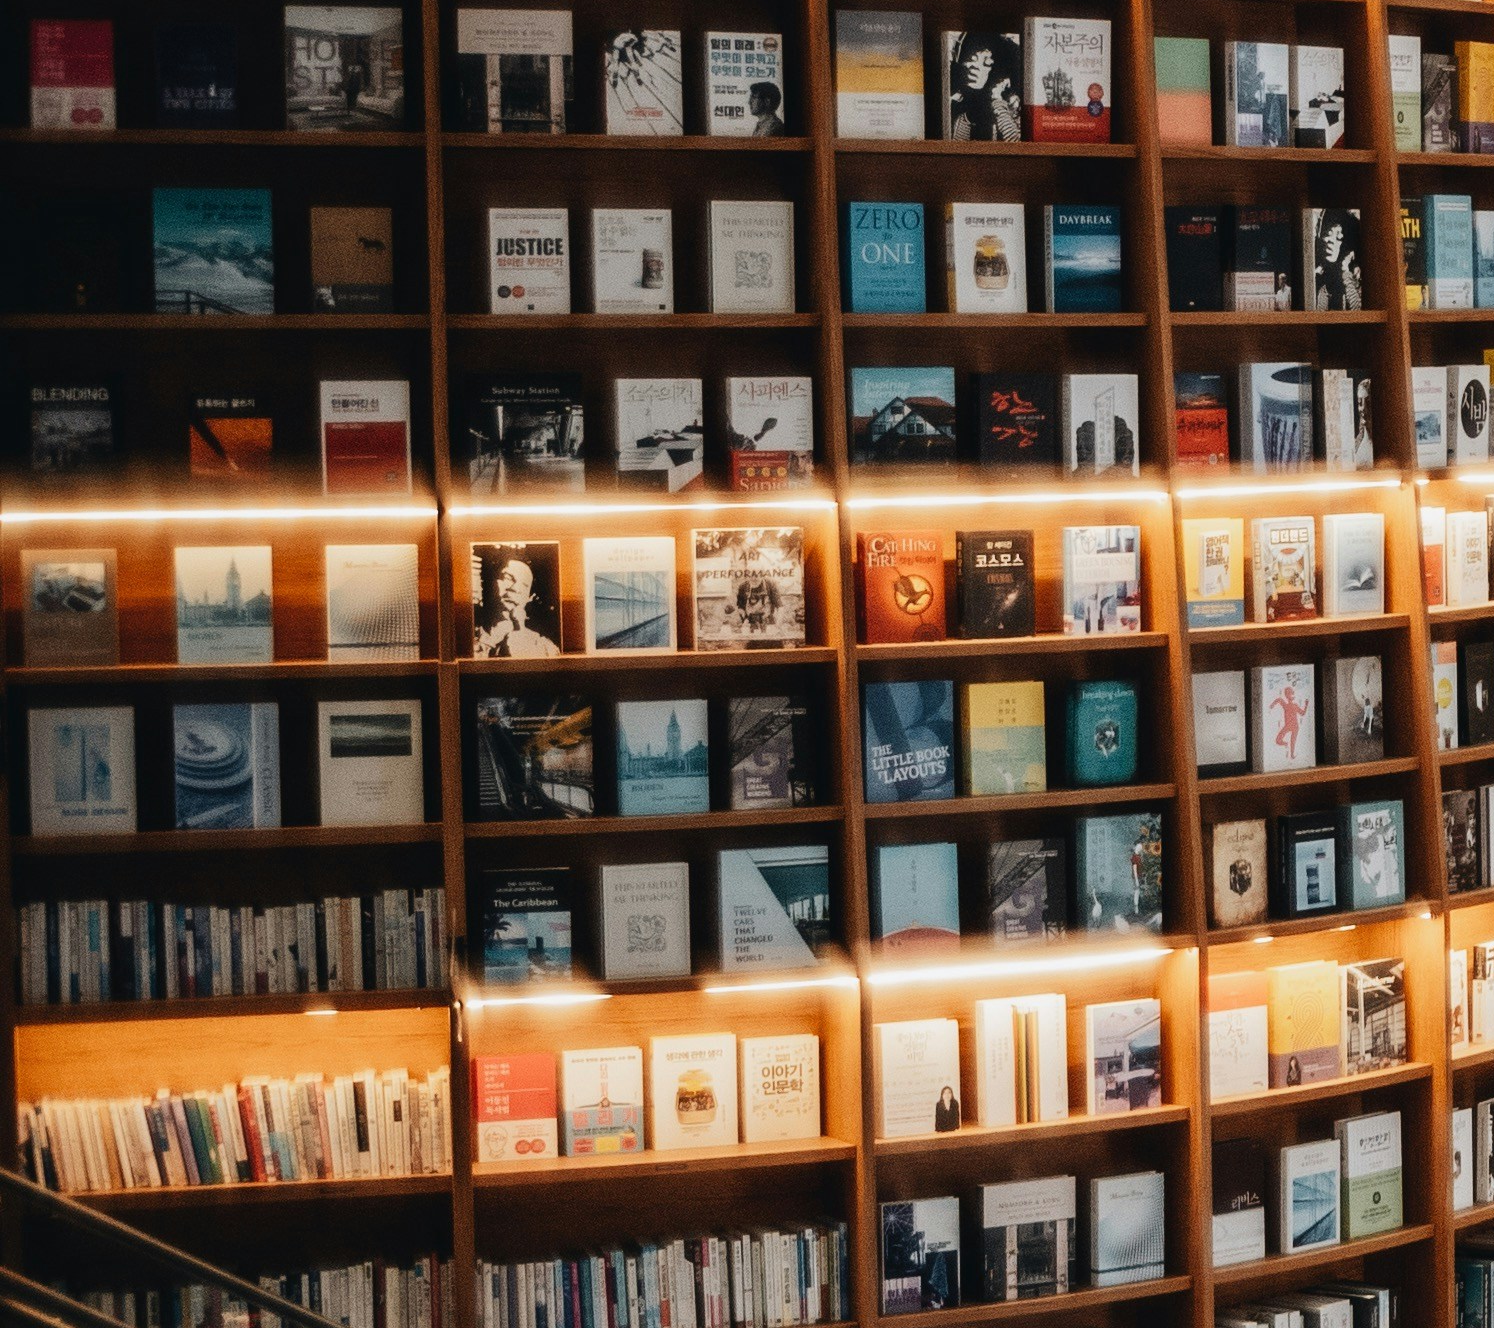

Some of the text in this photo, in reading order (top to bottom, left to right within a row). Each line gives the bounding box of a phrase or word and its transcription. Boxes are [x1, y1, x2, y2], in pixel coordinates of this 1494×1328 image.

[1044, 31, 1104, 56] 자본주의
[713, 105, 744, 118] 선대인
[855, 208, 921, 232] ZERO
[1059, 214, 1113, 226] DAYBREAK
[496, 236, 564, 256] JUSTICE
[861, 242, 915, 265] ONE
[31, 386, 109, 402] BLENDING
[491, 386, 561, 398] Subway Station
[738, 381, 808, 402] 사피엔스
[1269, 527, 1309, 546] 원더랜드
[871, 537, 936, 553] CATCHING
[868, 553, 896, 567] FIRE
[975, 553, 1024, 568] 코스모스
[871, 744, 892, 756] THE
[871, 745, 951, 771] LITTLE BOOK
[884, 760, 947, 785] LAYOUTS
[493, 898, 559, 909] The Caribbean
[734, 908, 768, 918] TWELVE
[734, 918, 755, 927] CARS
[735, 926, 756, 935] THAT
[734, 934, 774, 945] CHANGED
[736, 946, 750, 954] THE
[735, 953, 765, 964] WORLD
[761, 1063, 803, 1080] 이야기
[762, 1079, 804, 1096] 인문학
